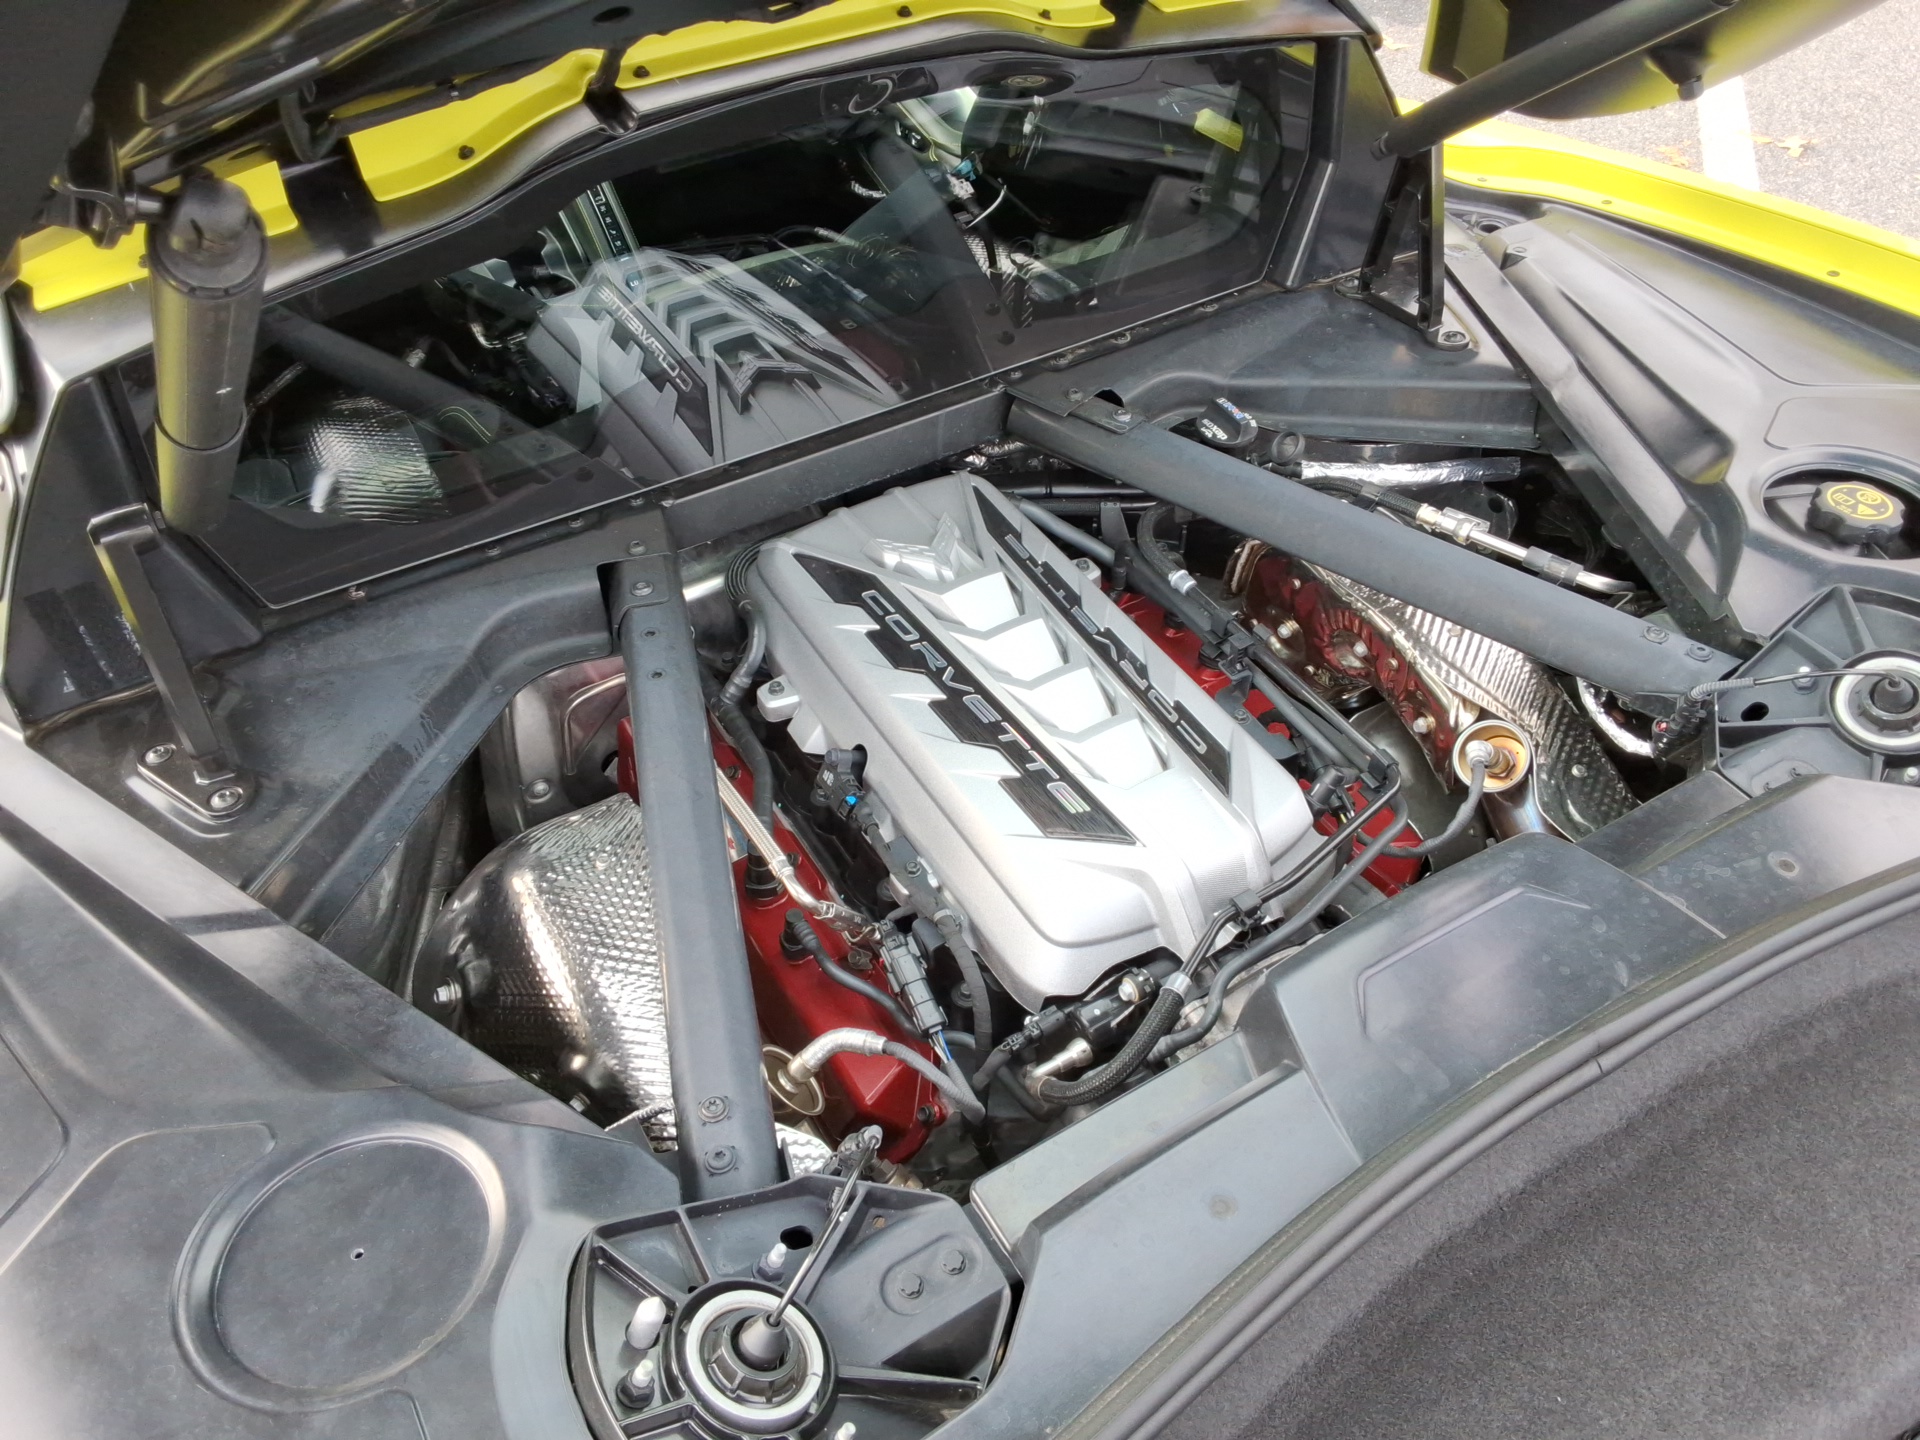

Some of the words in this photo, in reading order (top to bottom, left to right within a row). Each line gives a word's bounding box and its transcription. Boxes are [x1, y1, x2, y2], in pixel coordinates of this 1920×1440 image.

[1201, 418, 1228, 440] dexos
[861, 589, 1092, 815] CORVETTE
[1004, 533, 1207, 755] CORVETTE
